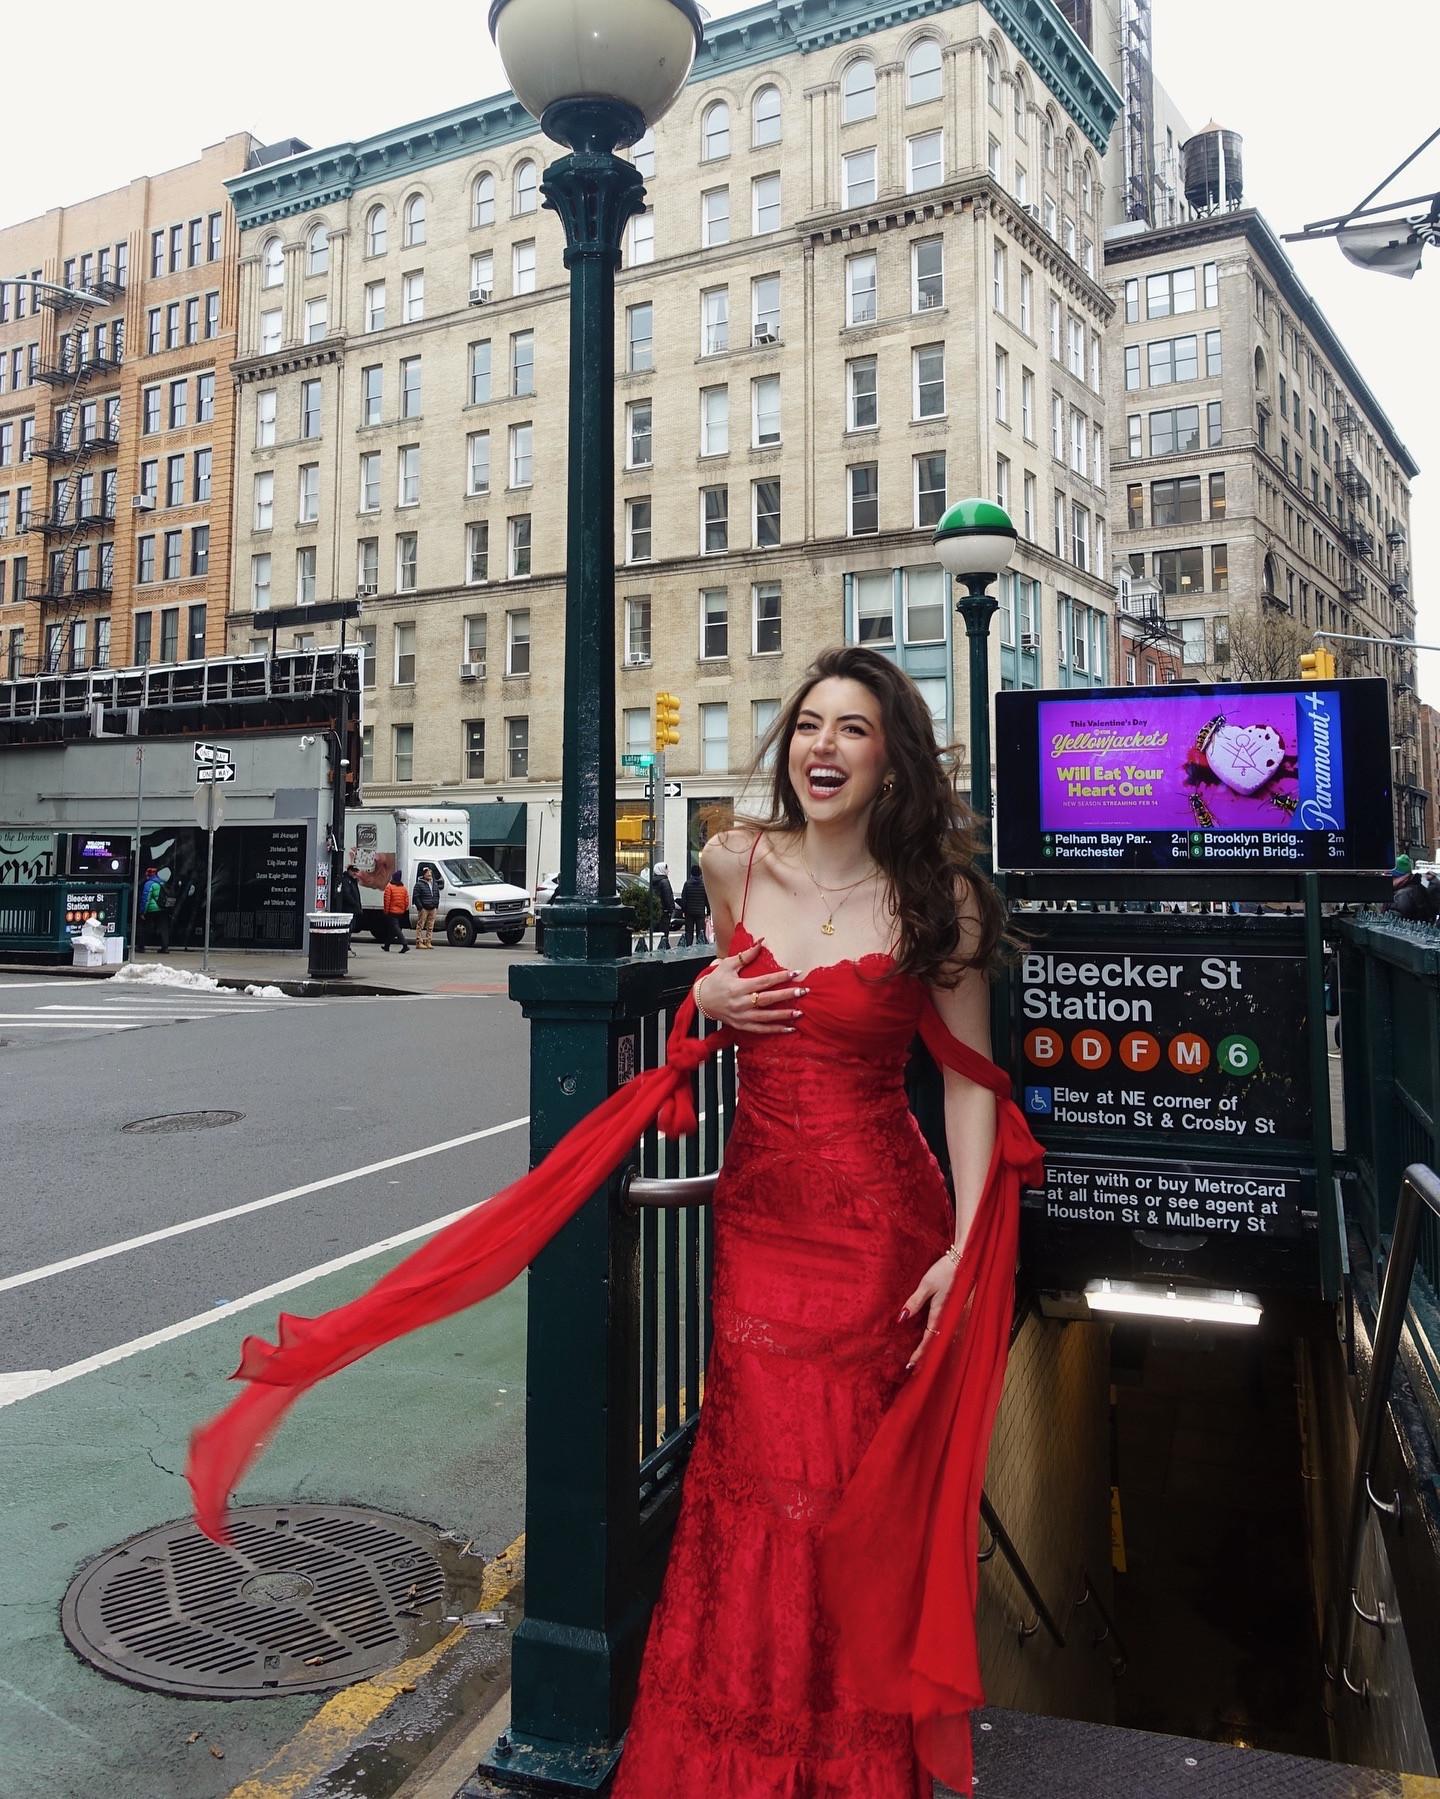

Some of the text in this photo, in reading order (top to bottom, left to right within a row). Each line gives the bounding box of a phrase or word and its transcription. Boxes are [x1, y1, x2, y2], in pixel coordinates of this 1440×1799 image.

[1070, 718, 1148, 728] This Valentine's Day
[1050, 730, 1169, 758] Yellowjackets
[1300, 691, 1340, 830] Paramount+
[218, 769, 229, 777] WAY
[1056, 765, 1164, 781] Will Eat Your
[1068, 781, 1153, 797] Heart Out
[4, 831, 50, 841] the Darkness
[413, 826, 463, 847] Jones
[1055, 834, 1098, 844] Pelham
[1101, 834, 1123, 846] Bay
[1126, 834, 1152, 844] Par..
[1171, 834, 1187, 844] 2m
[1204, 833, 1259, 846] Brooklyn
[1262, 833, 1304, 846] Bridg..
[1327, 833, 1345, 843] 2m
[1055, 847, 1124, 857] Parkchester
[1172, 847, 1188, 857] 6m
[1204, 846, 1260, 859] Brooklyn
[1263, 846, 1305, 859] Bridg..
[1328, 846, 1345, 857] 3m
[66, 894, 104, 902] Bleecker St
[66, 902, 90, 910] Station
[1022, 954, 1242, 990] Bleecker St
[1022, 988, 1153, 1022] Station
[1035, 1036, 1248, 1068] B D F M 6
[1053, 1087, 1238, 1111] Elev at NE corner of
[1053, 1107, 1276, 1135] Houston St & Crosby St
[1046, 1169, 1287, 1198] Enter with or buy MetroCard
[1047, 1188, 1278, 1216] at all times or see agent at
[1047, 1203, 1267, 1233] Houston St & Mulberry St
